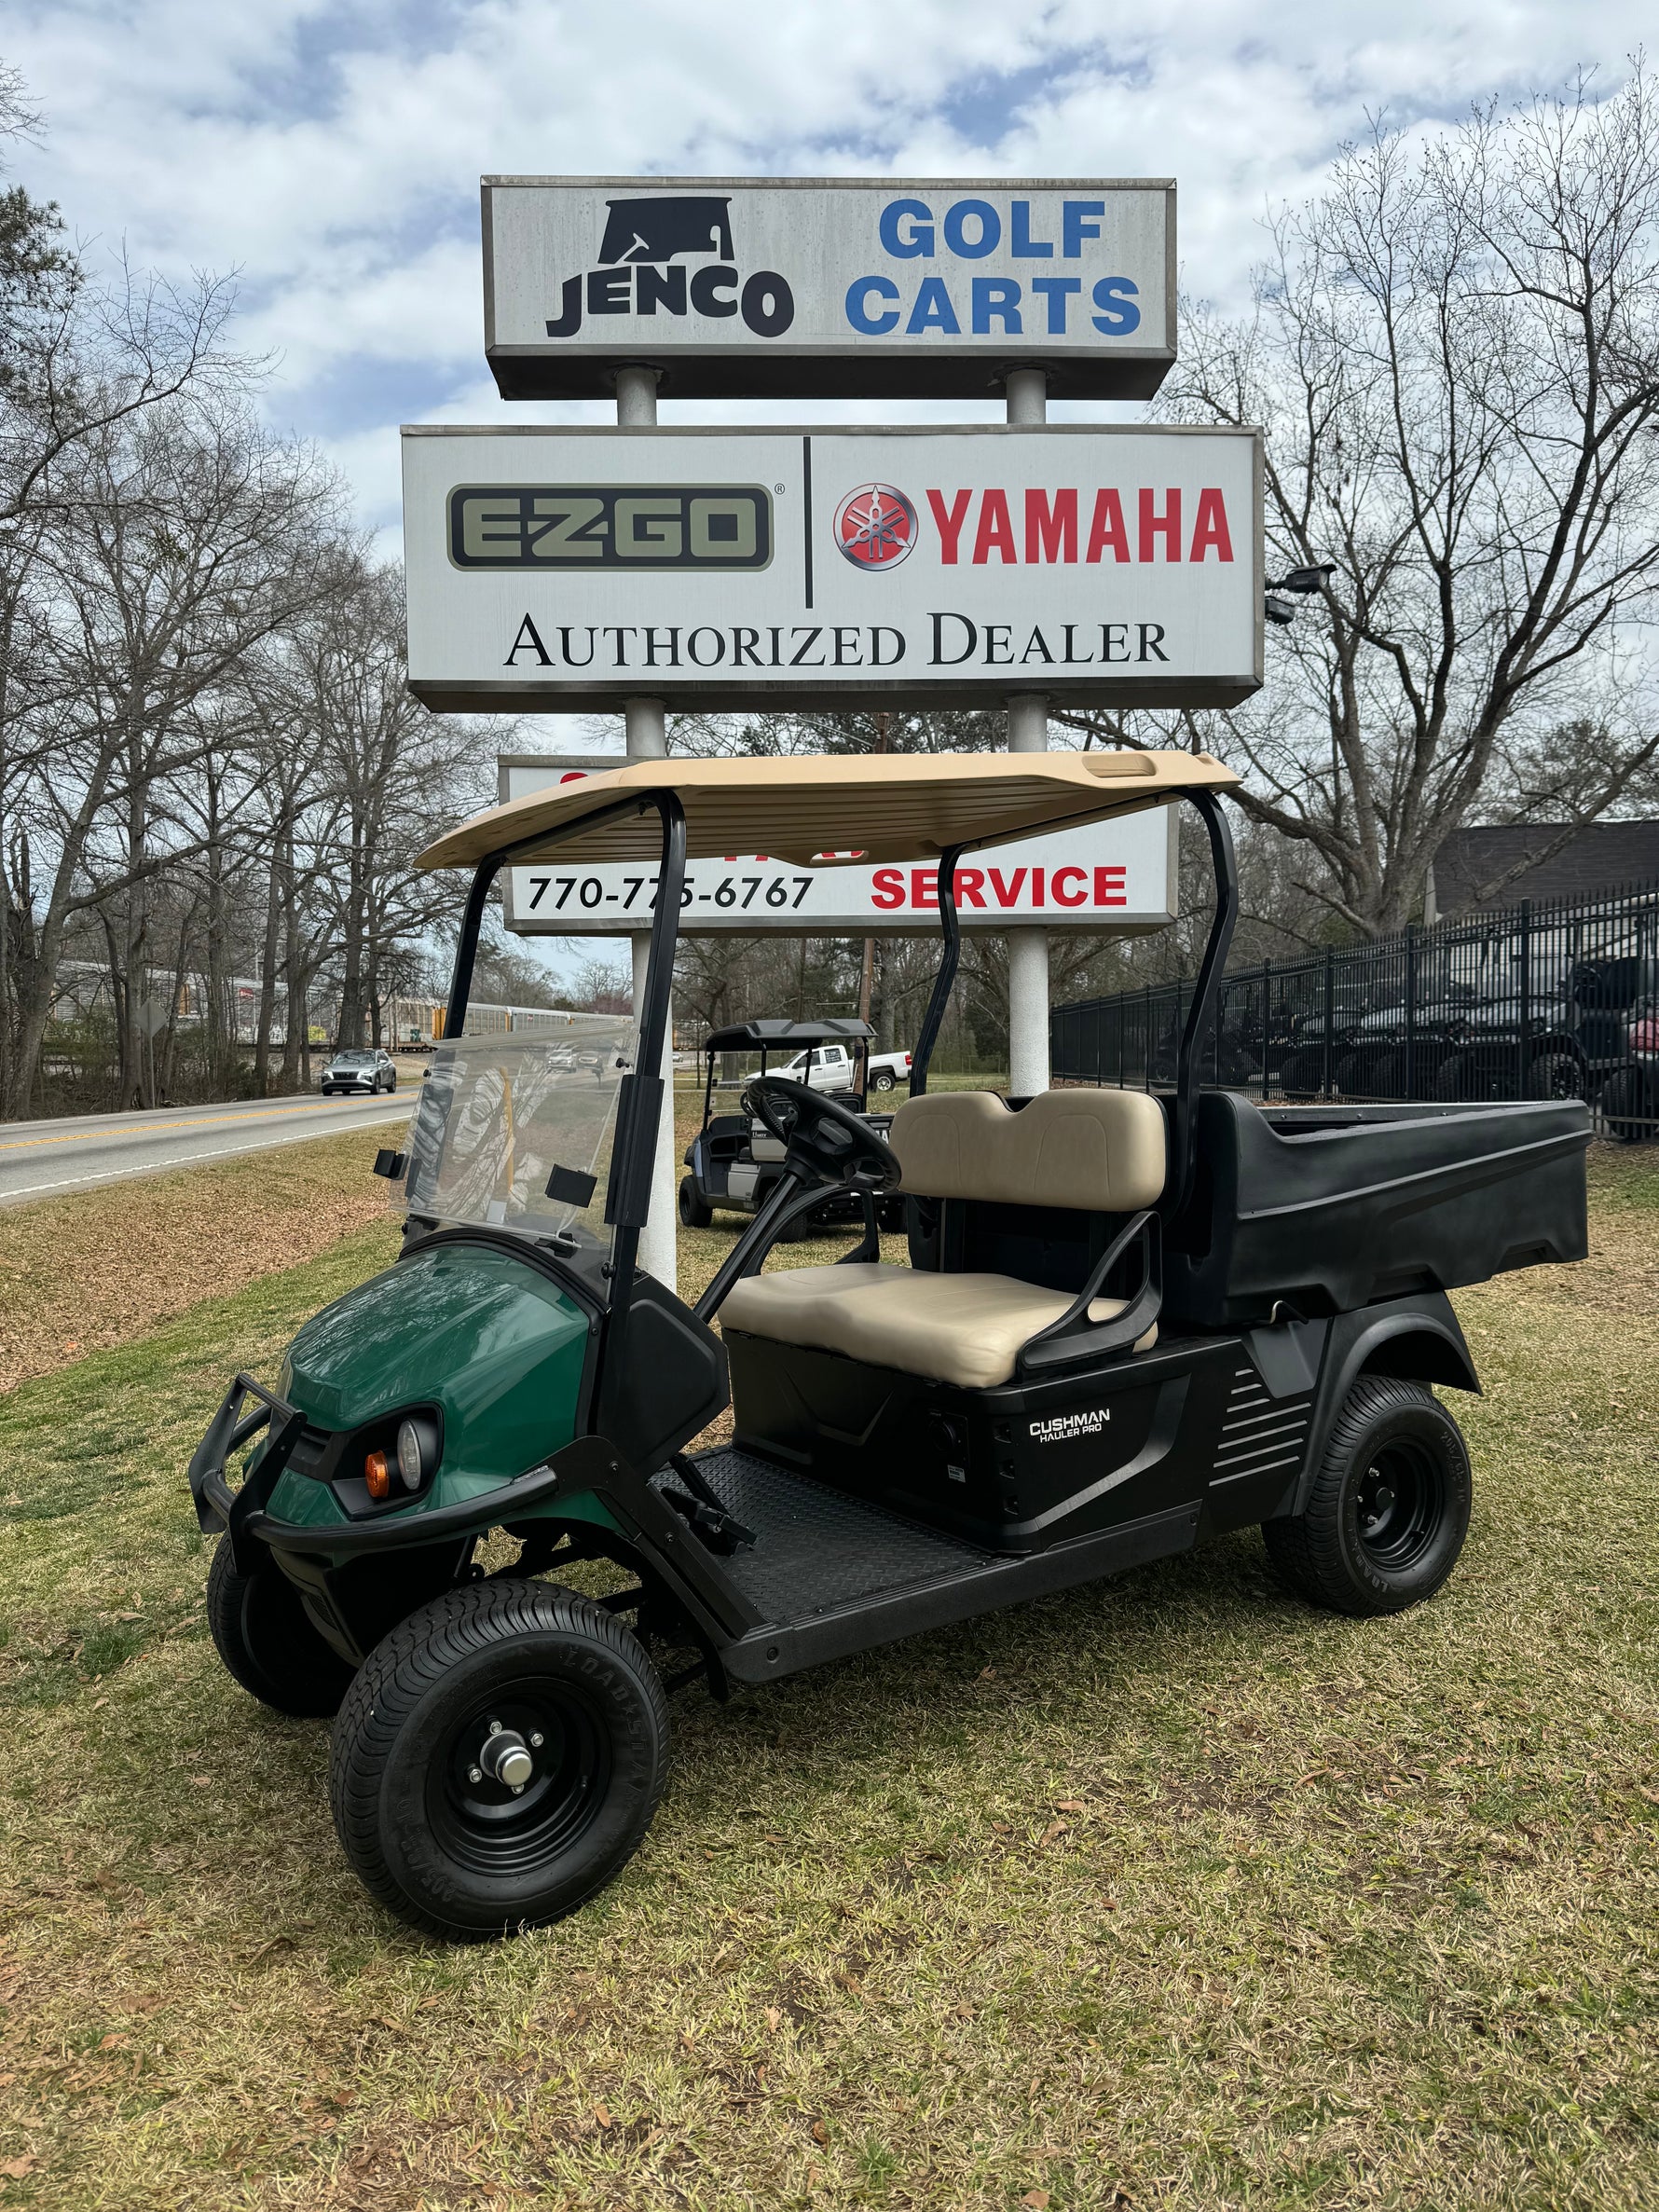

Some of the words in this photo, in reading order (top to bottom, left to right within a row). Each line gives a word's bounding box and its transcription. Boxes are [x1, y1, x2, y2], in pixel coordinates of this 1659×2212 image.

[879, 199, 1105, 259] GOLF
[545, 265, 795, 338] JENCO
[845, 275, 1141, 337] CARTS
[462, 498, 757, 557] EZGO
[925, 488, 1234, 565] YAMAHA
[502, 612, 906, 667] AUTHORIZED
[926, 612, 1171, 666] DEALER
[871, 866, 1127, 910] SERVICE
[1029, 1408, 1110, 1436] CUSHMAN
[1039, 1427, 1080, 1443] HAULER
[1082, 1422, 1103, 1434] PRO
